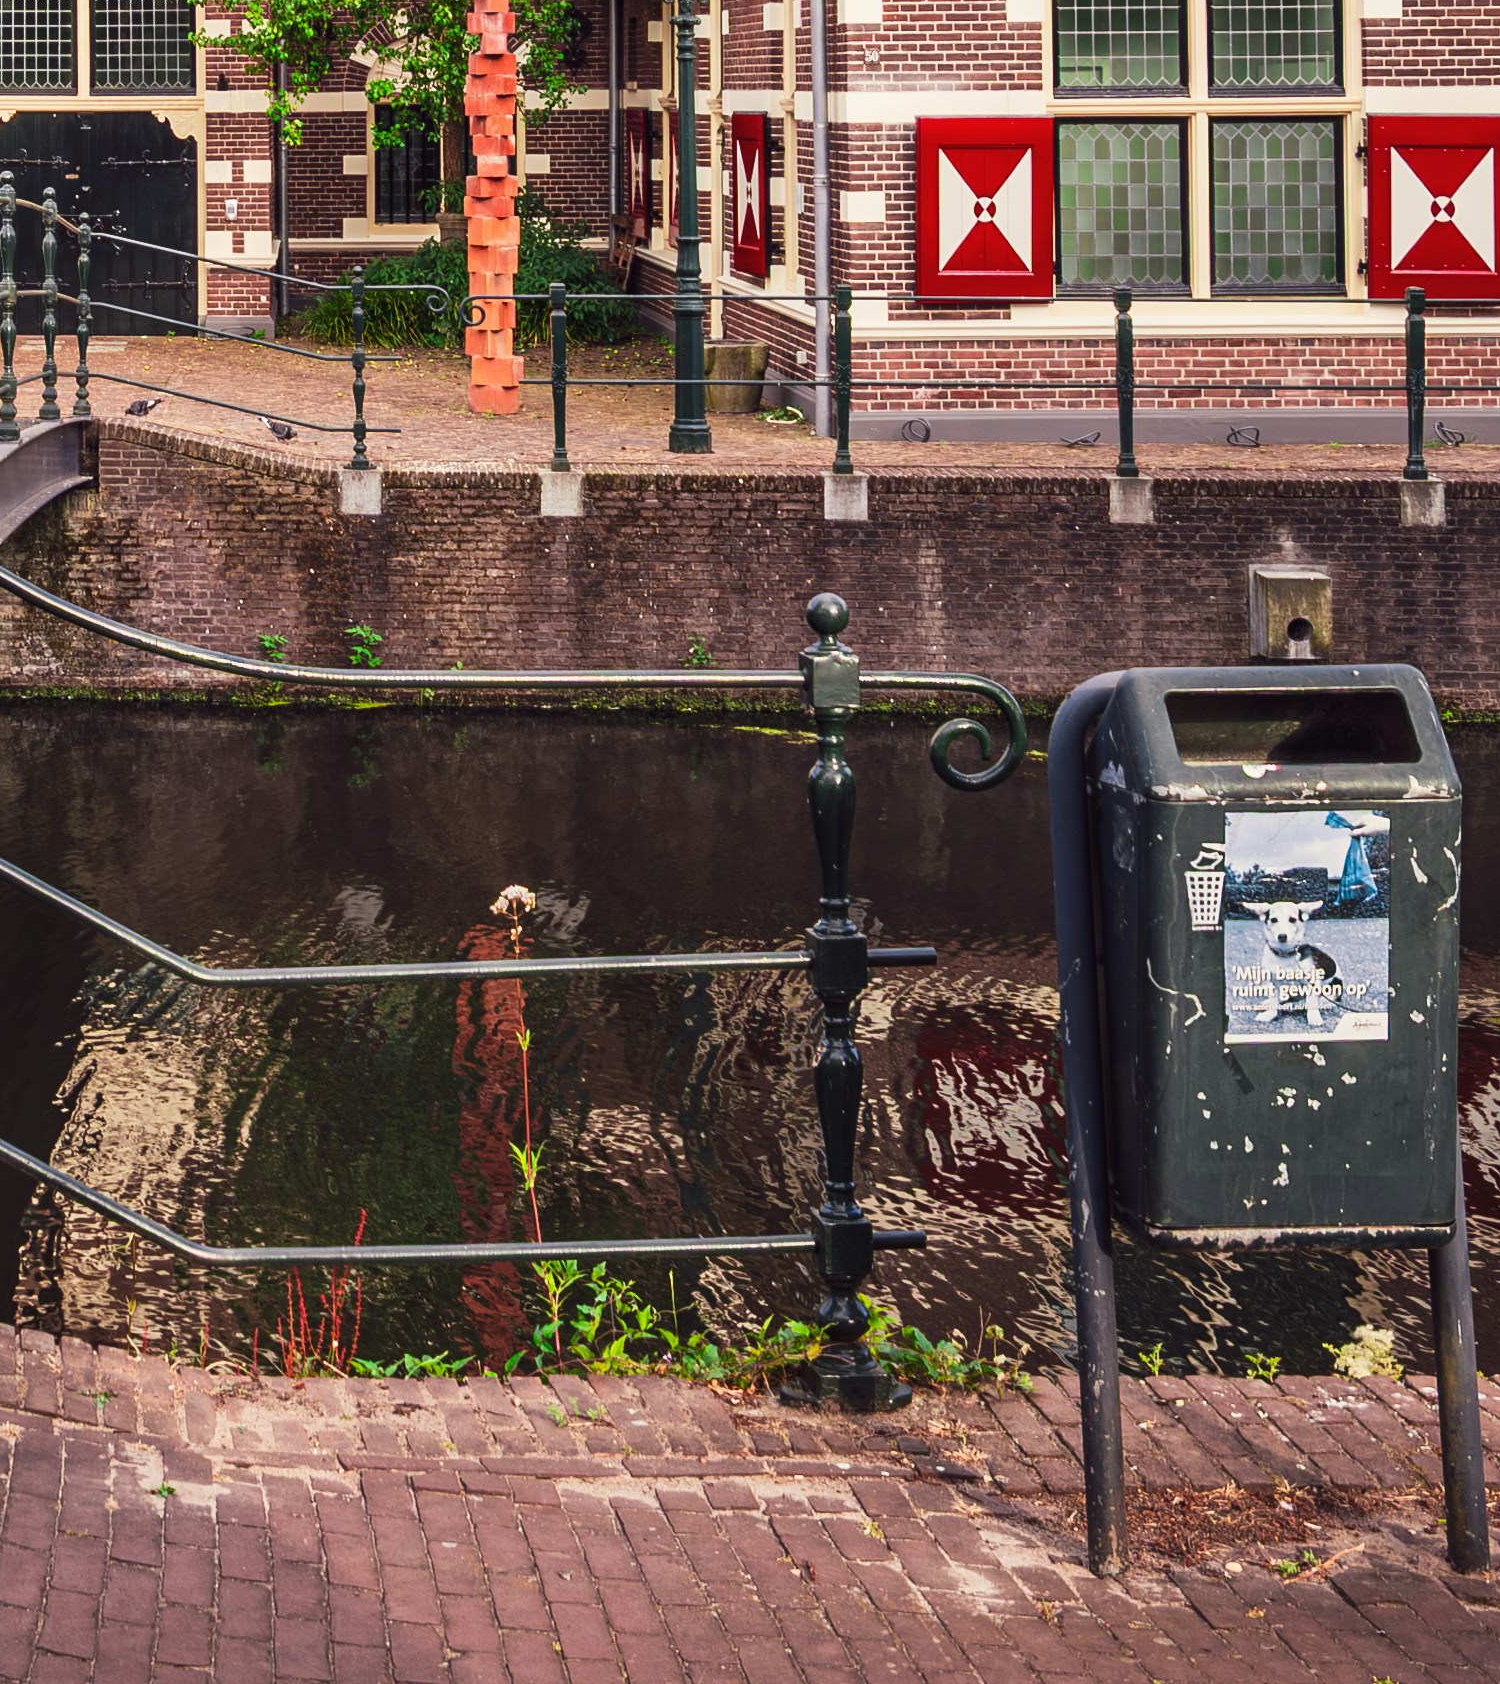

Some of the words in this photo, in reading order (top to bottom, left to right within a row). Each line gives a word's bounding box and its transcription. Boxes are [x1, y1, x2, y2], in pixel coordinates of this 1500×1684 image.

[865, 50, 879, 62] 50
[1276, 966, 1326, 985] baasje
[1232, 983, 1276, 998] ruimt
[1279, 984, 1342, 1001] gewoon
